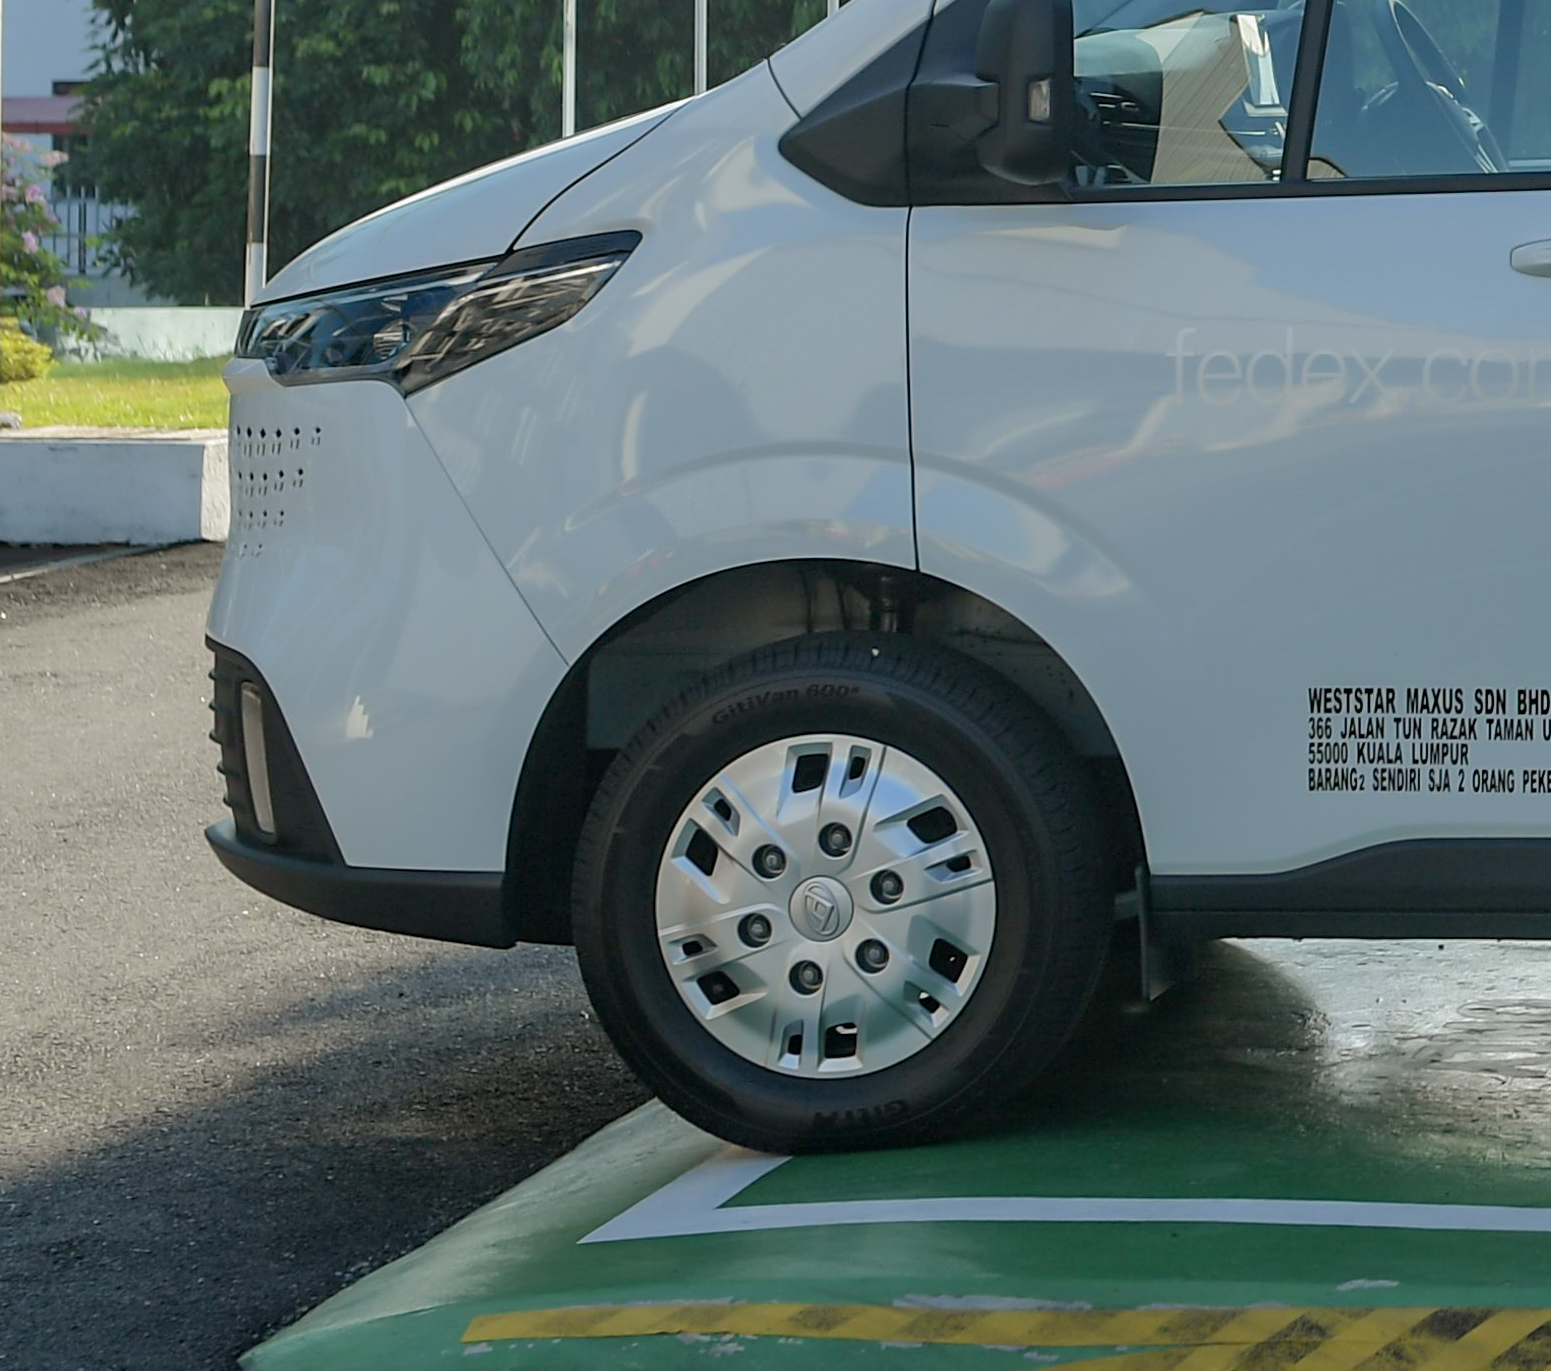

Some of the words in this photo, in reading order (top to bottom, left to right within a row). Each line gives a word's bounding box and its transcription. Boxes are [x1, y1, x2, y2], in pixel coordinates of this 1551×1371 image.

[1308, 688, 1396, 715] WESTSTAR
[1406, 688, 1463, 715] MAXUS
[1474, 688, 1507, 716] SDN
[1517, 688, 1551, 716] BHD
[1308, 717, 1332, 740] 366
[1340, 717, 1385, 740] JALAN
[1393, 717, 1422, 740] TUN
[1430, 717, 1478, 741] RAZAK
[1485, 718, 1534, 742] TAMAN
[1542, 718, 1551, 742] U
[1308, 742, 1349, 765] 55000
[1356, 742, 1404, 765] KUALA
[1411, 742, 1469, 766] LUMPUR
[1372, 767, 1421, 792] SENDIRI
[1428, 768, 1451, 793] SJA
[1457, 768, 1465, 793] 2
[1472, 768, 1515, 794] ORANG
